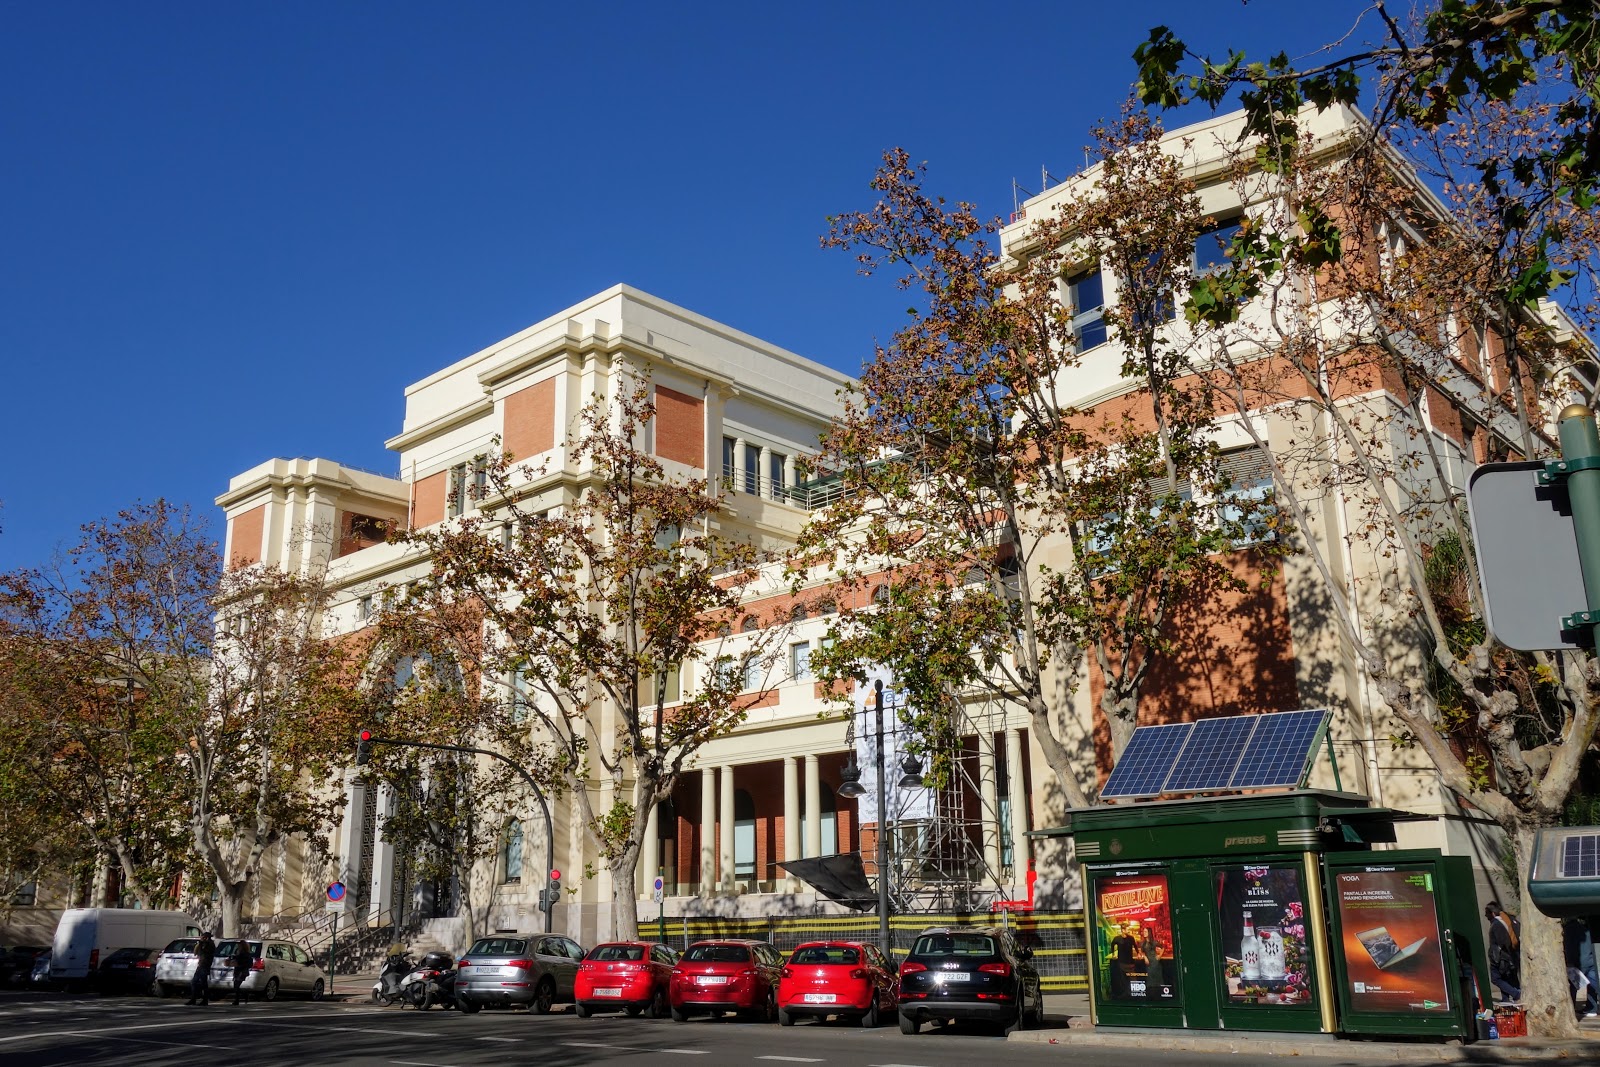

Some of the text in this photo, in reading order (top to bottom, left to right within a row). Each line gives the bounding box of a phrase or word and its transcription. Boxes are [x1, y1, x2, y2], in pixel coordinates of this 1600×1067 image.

[1224, 835, 1266, 848] prensa
[1137, 887, 1163, 905] LOVE
[1130, 983, 1146, 991] HBO
